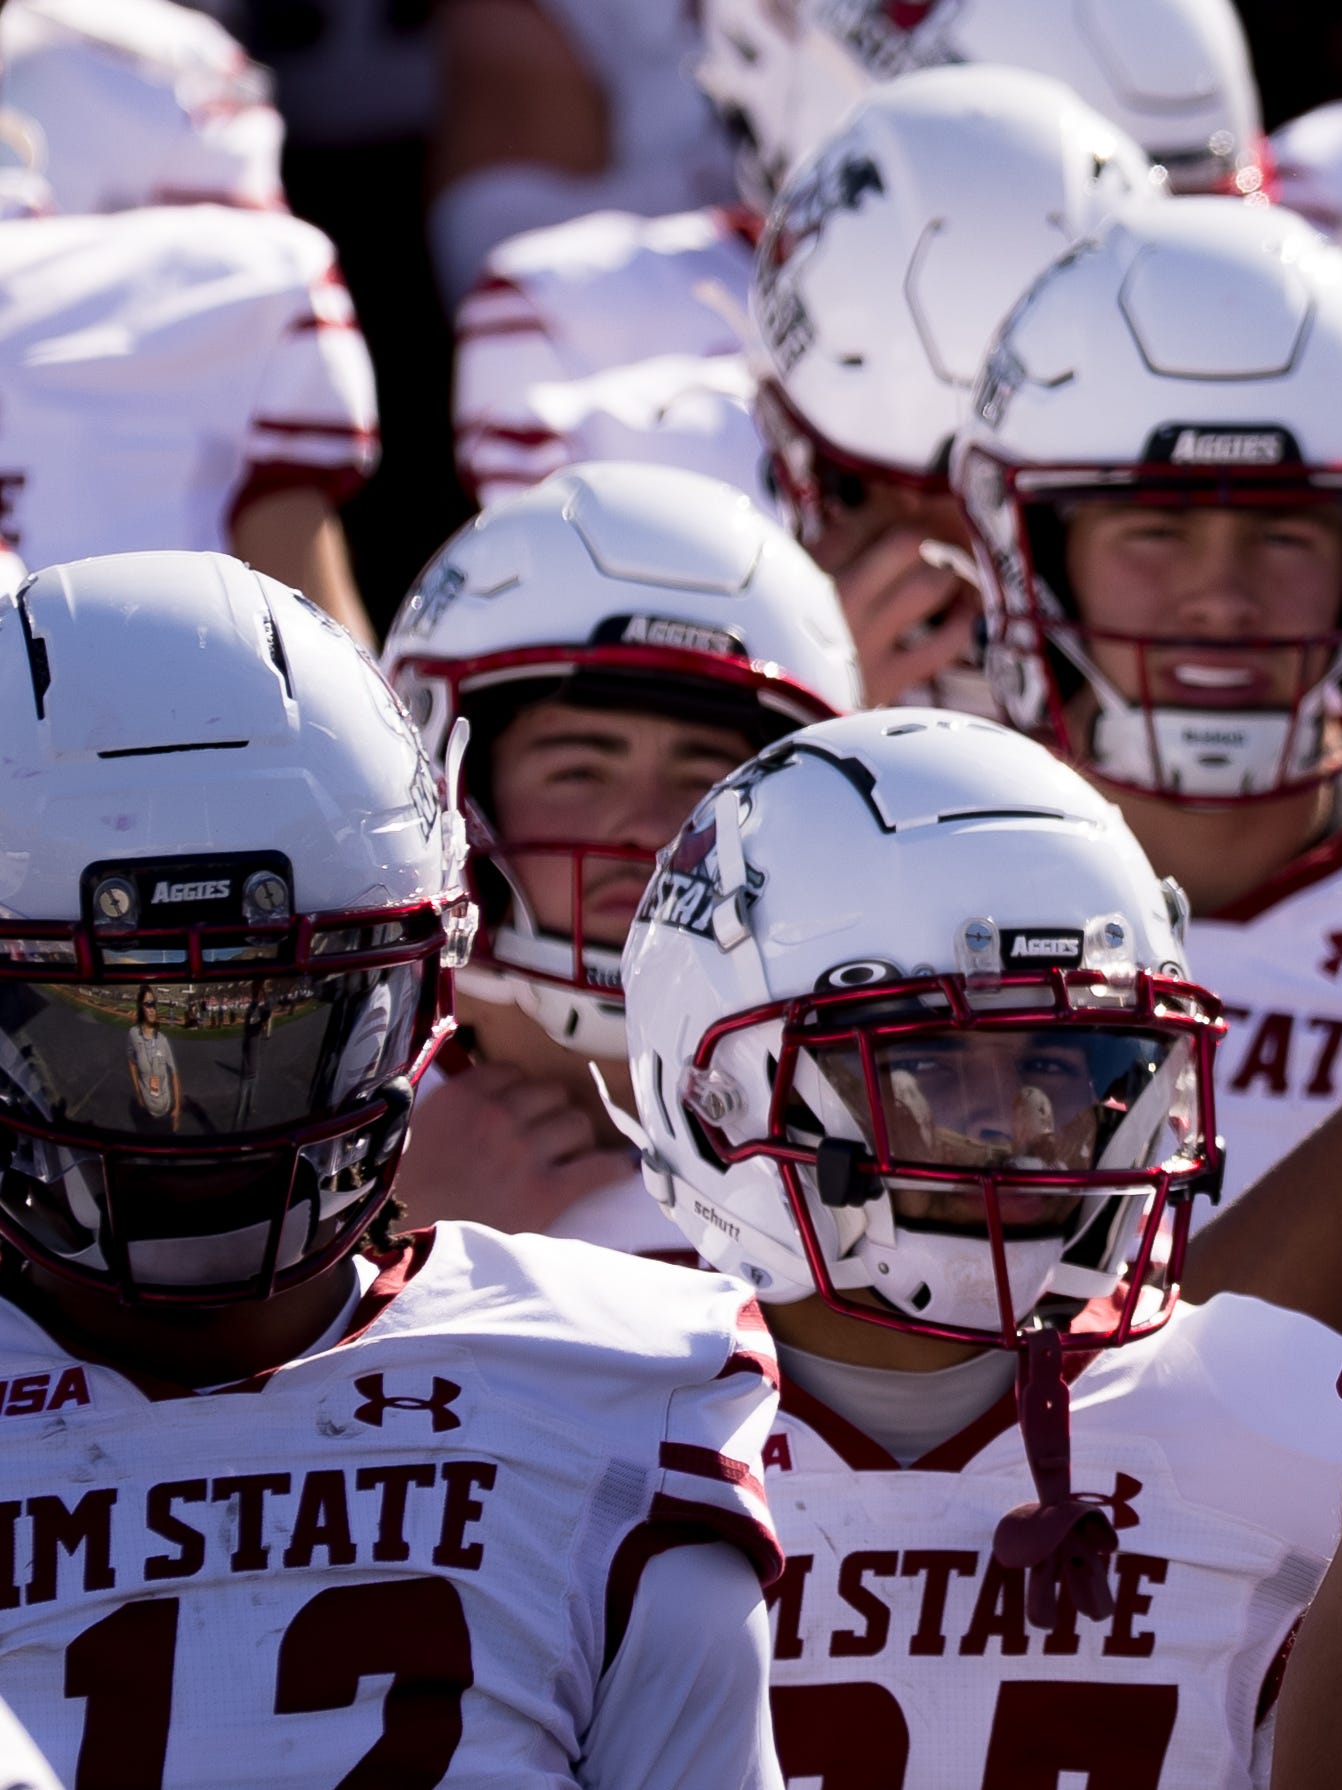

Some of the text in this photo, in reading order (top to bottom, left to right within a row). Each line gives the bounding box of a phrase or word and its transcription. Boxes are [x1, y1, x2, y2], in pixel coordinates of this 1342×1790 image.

[150, 880, 231, 904] AGGIES
[1010, 934, 1080, 958] AGGIES
[693, 1199, 741, 1243] schutt
[0, 1366, 91, 1417] SA
[143, 1460, 498, 1582] STATE
